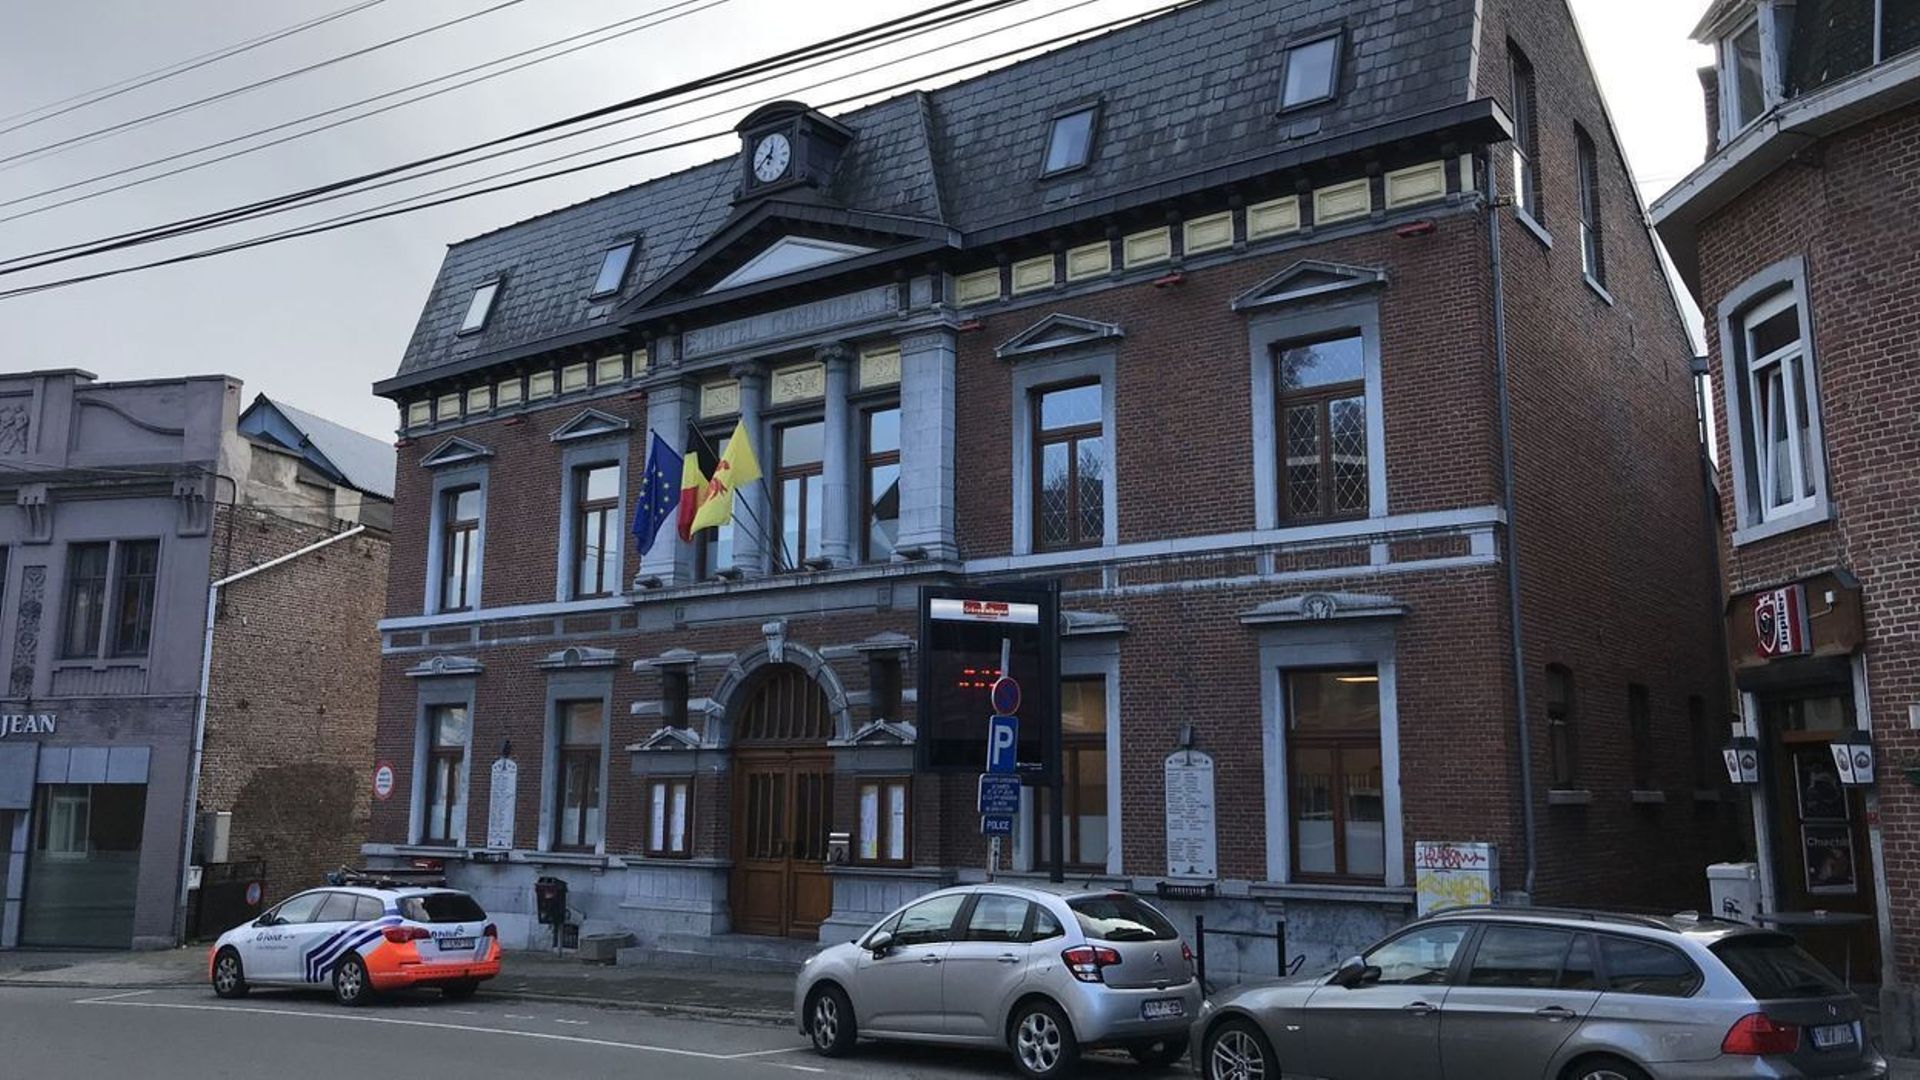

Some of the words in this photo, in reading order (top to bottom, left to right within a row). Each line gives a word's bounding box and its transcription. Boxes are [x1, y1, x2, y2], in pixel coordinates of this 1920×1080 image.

[1777, 592, 1790, 650] Jupiler
[0, 714, 57, 738] JEAN
[993, 725, 1014, 765] P
[986, 820, 1010, 831] POLICE
[835, 847, 844, 861] 2
